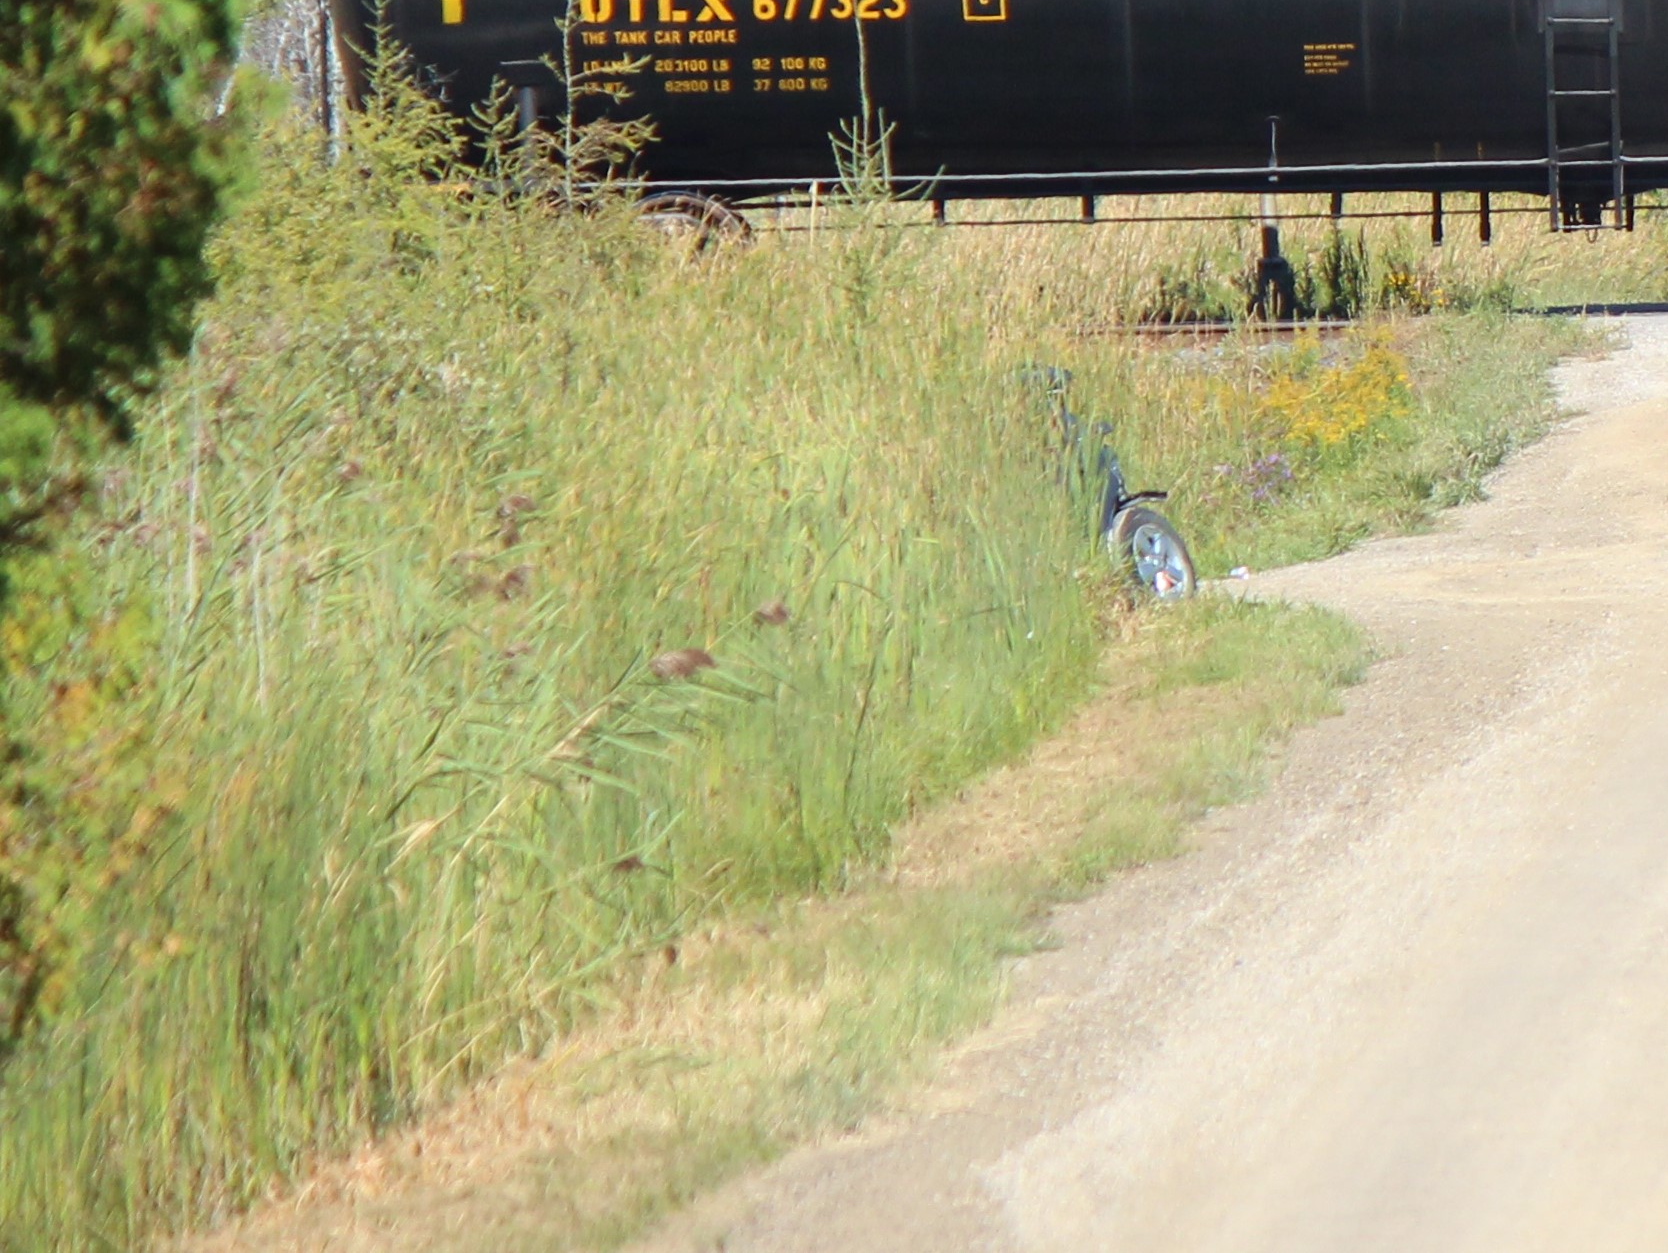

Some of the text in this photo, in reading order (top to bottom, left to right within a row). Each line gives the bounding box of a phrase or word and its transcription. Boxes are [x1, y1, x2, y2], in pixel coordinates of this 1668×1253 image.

[581, 28, 737, 45] THE TANK CAR PEOPLE
